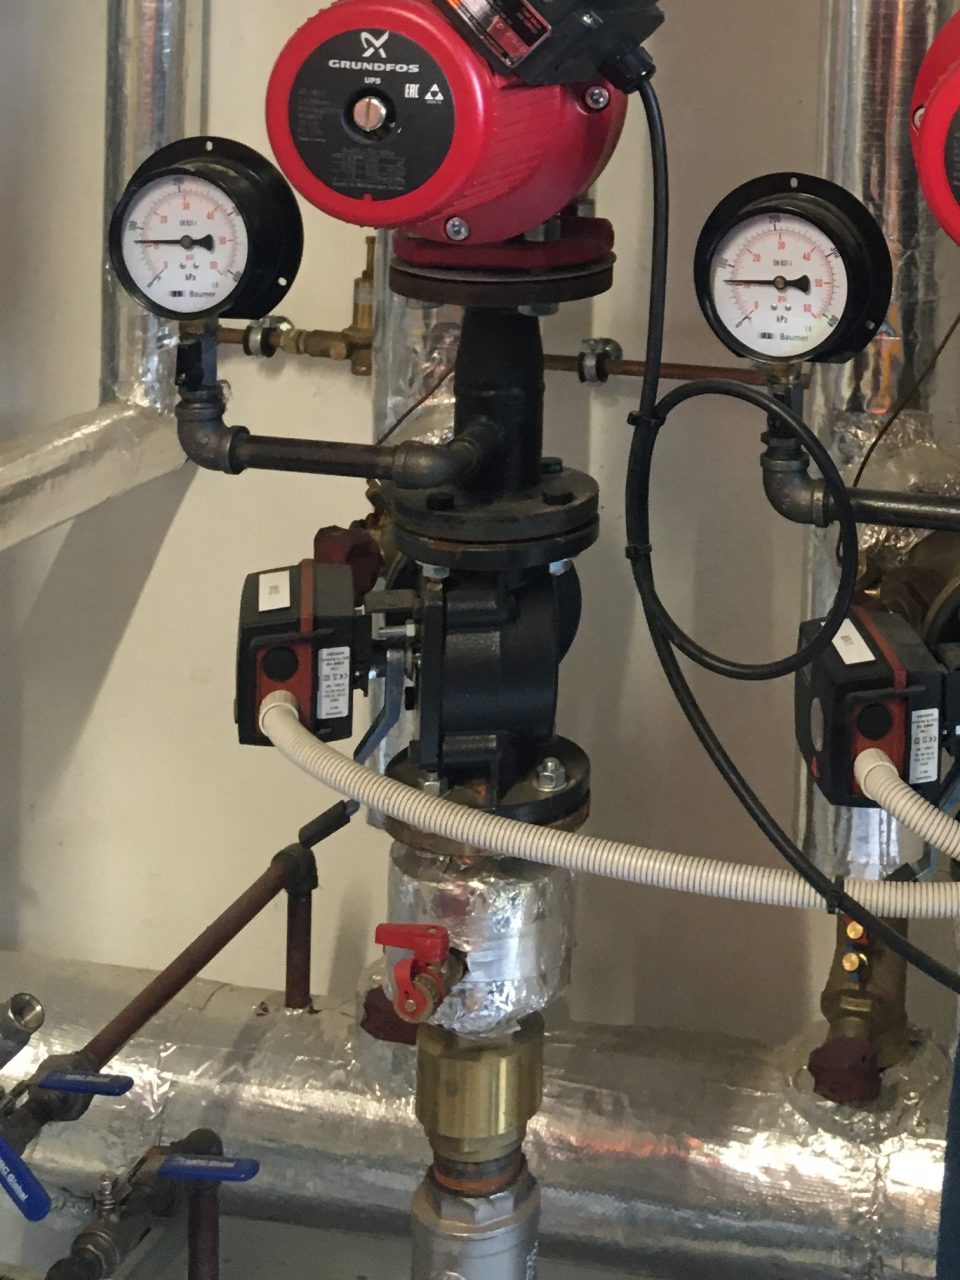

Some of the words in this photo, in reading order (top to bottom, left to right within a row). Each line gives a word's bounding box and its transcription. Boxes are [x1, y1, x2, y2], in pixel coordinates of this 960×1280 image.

[328, 59, 420, 73] GRUNDFOS
[364, 77, 382, 85] UPS
[404, 83, 421, 99] EAC
[776, 315, 788, 323] kPa
[779, 332, 809, 341] Baumer
